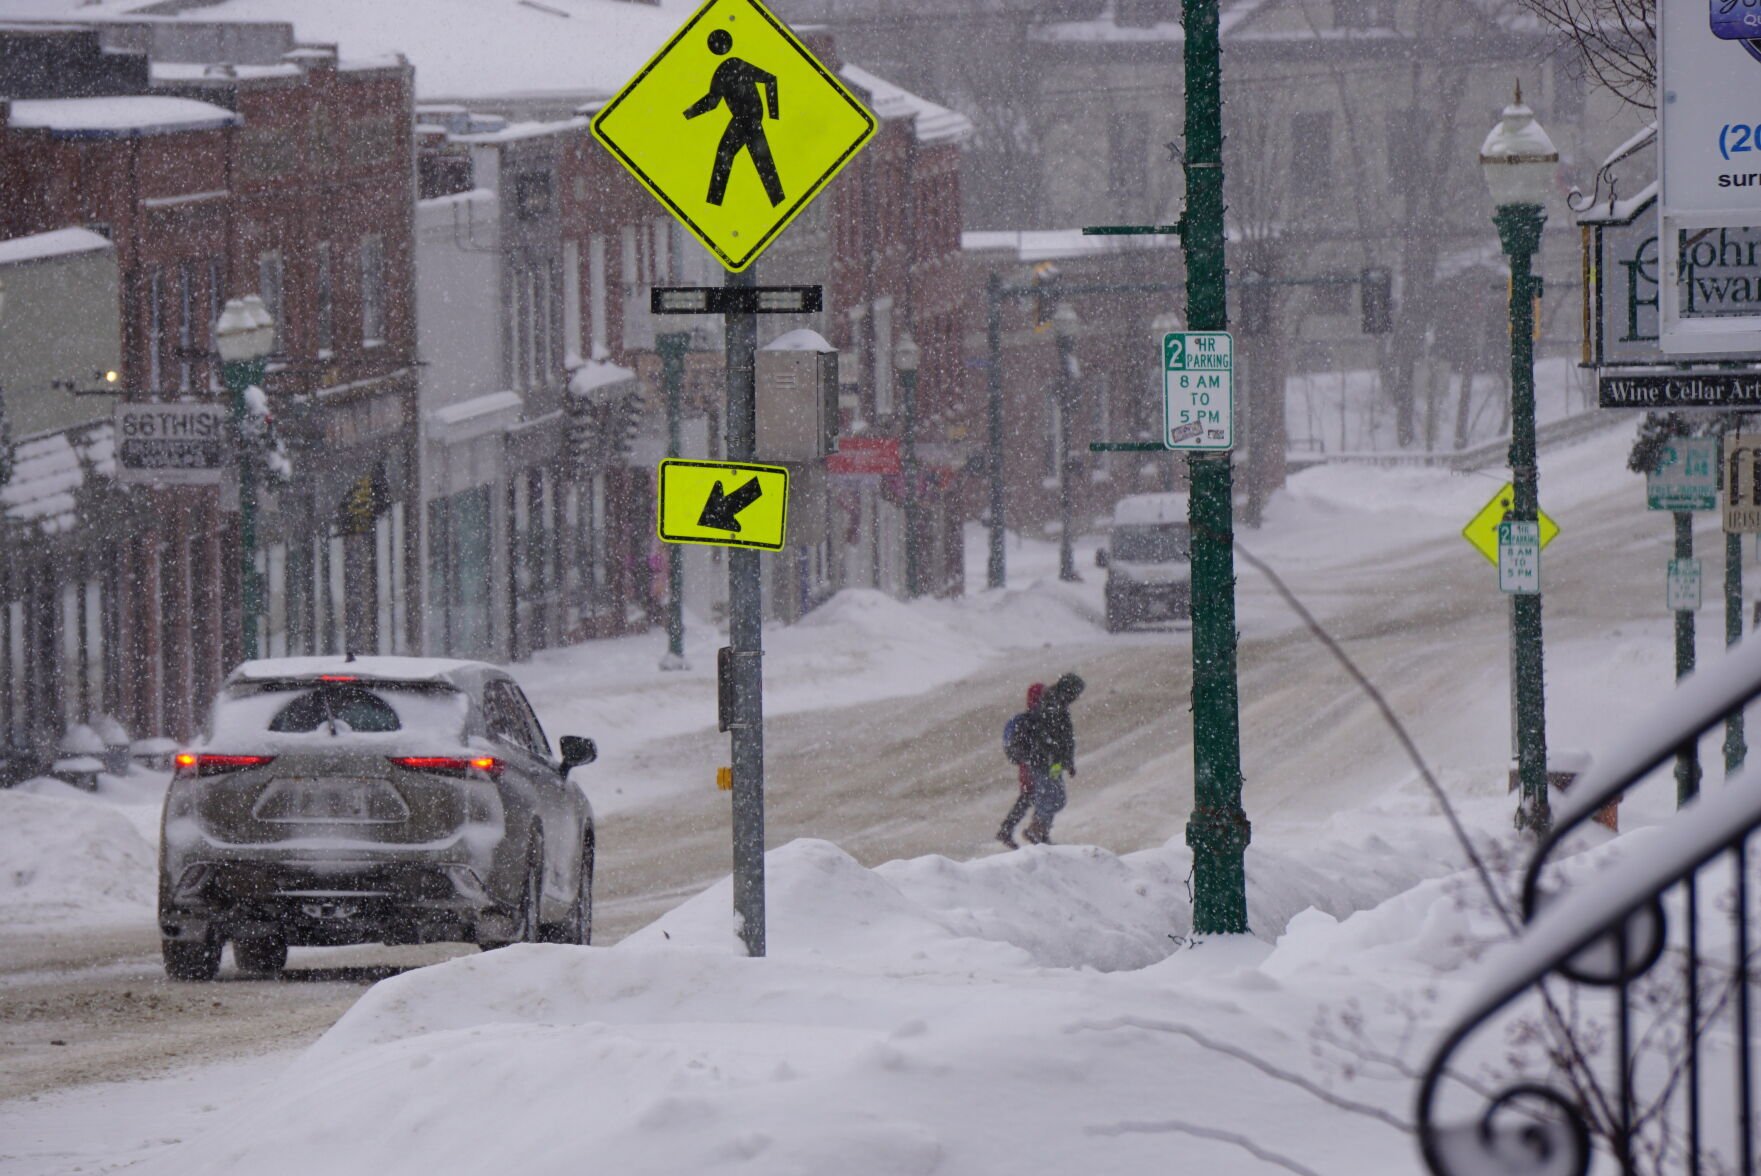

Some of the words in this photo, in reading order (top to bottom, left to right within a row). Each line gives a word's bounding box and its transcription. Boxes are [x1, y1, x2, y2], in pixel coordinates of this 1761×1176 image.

[1168, 339, 1184, 368] 2
[1198, 338, 1216, 352] HR
[1187, 354, 1229, 368] PARKING
[1180, 375, 1190, 388] 8
[1197, 375, 1220, 388] AM
[1611, 381, 1659, 401] Wine
[1665, 379, 1725, 400] Cellar
[1191, 393, 1210, 406] TO
[1180, 410, 1190, 423] 5
[1197, 410, 1220, 424] PM
[1501, 526, 1510, 545] 2
[1518, 548, 1532, 556] AM
[1514, 558, 1526, 566] TO
[1518, 569, 1532, 577] PM
